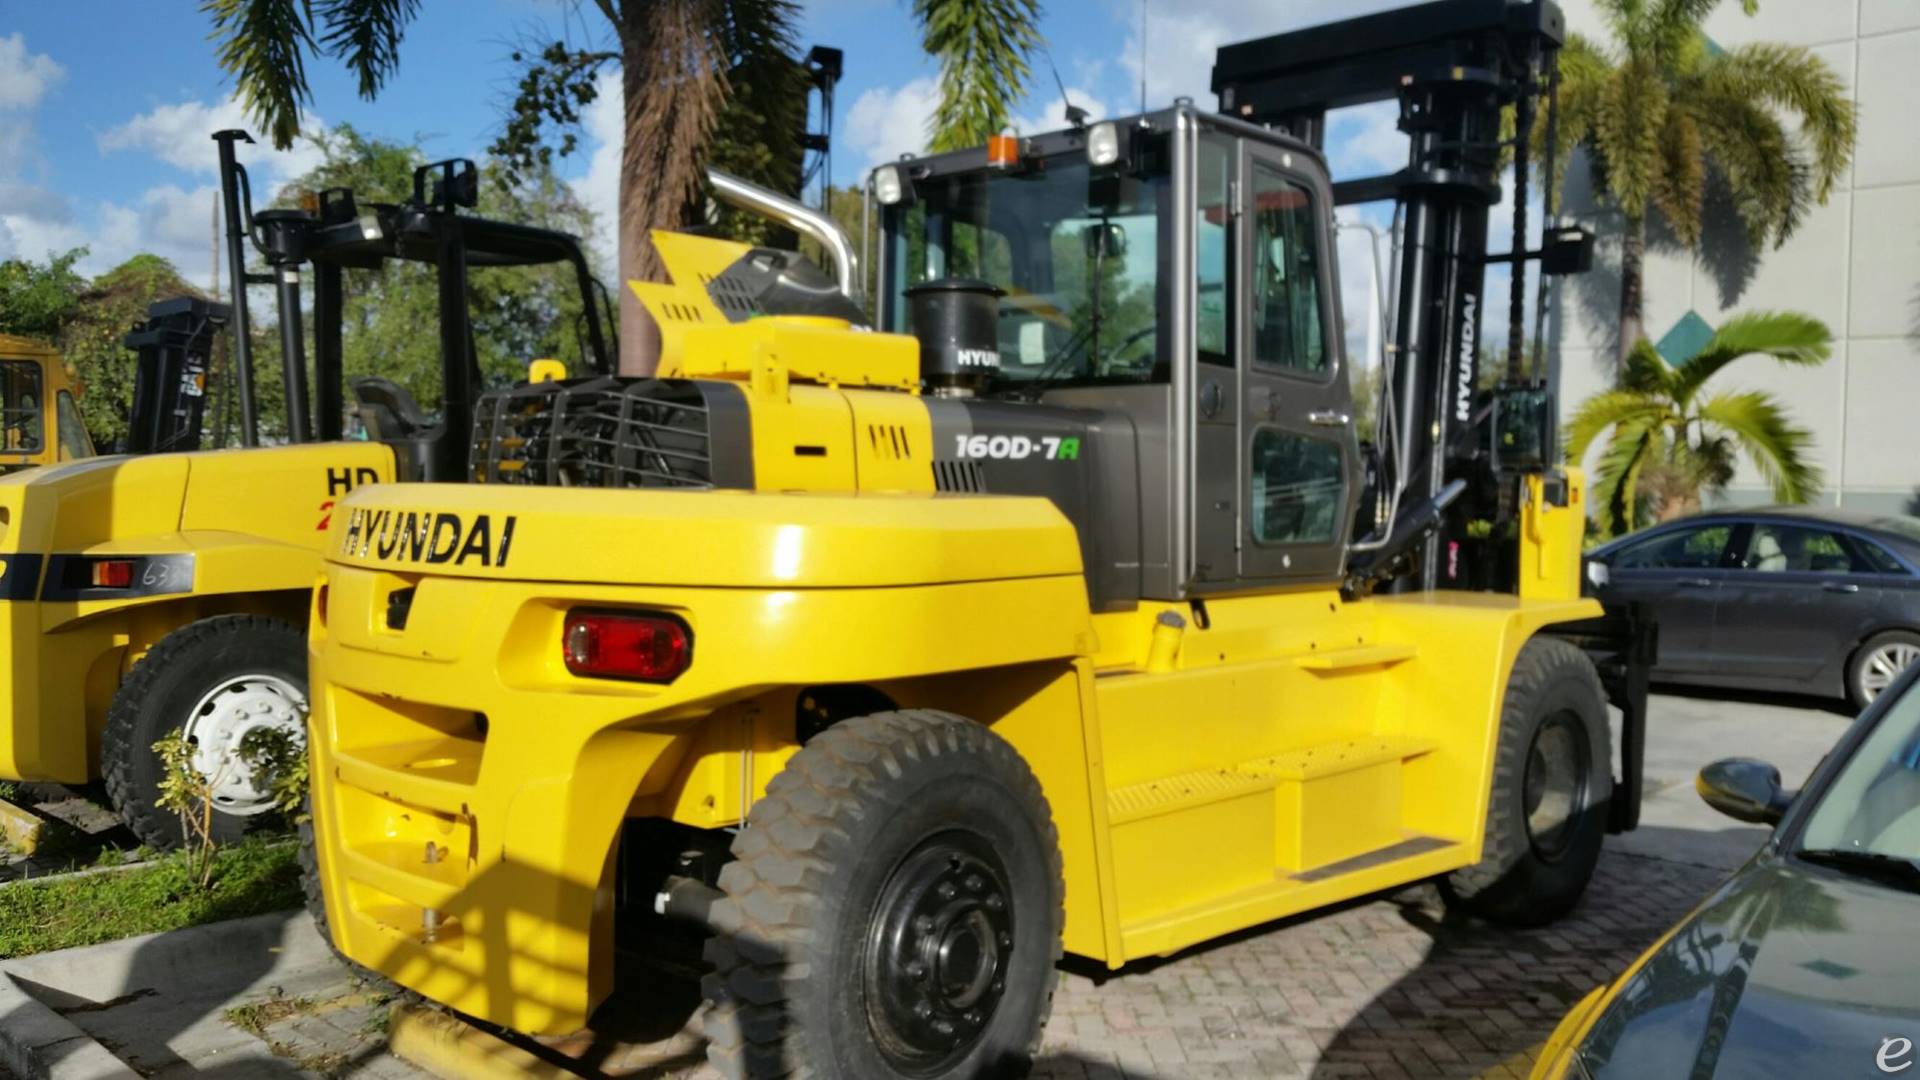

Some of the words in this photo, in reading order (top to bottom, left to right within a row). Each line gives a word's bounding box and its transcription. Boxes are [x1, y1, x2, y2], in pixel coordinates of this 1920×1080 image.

[1456, 294, 1476, 421] HYUNDAI
[956, 434, 1080, 460] 160D-7A
[344, 508, 517, 567] HYUNDAI
